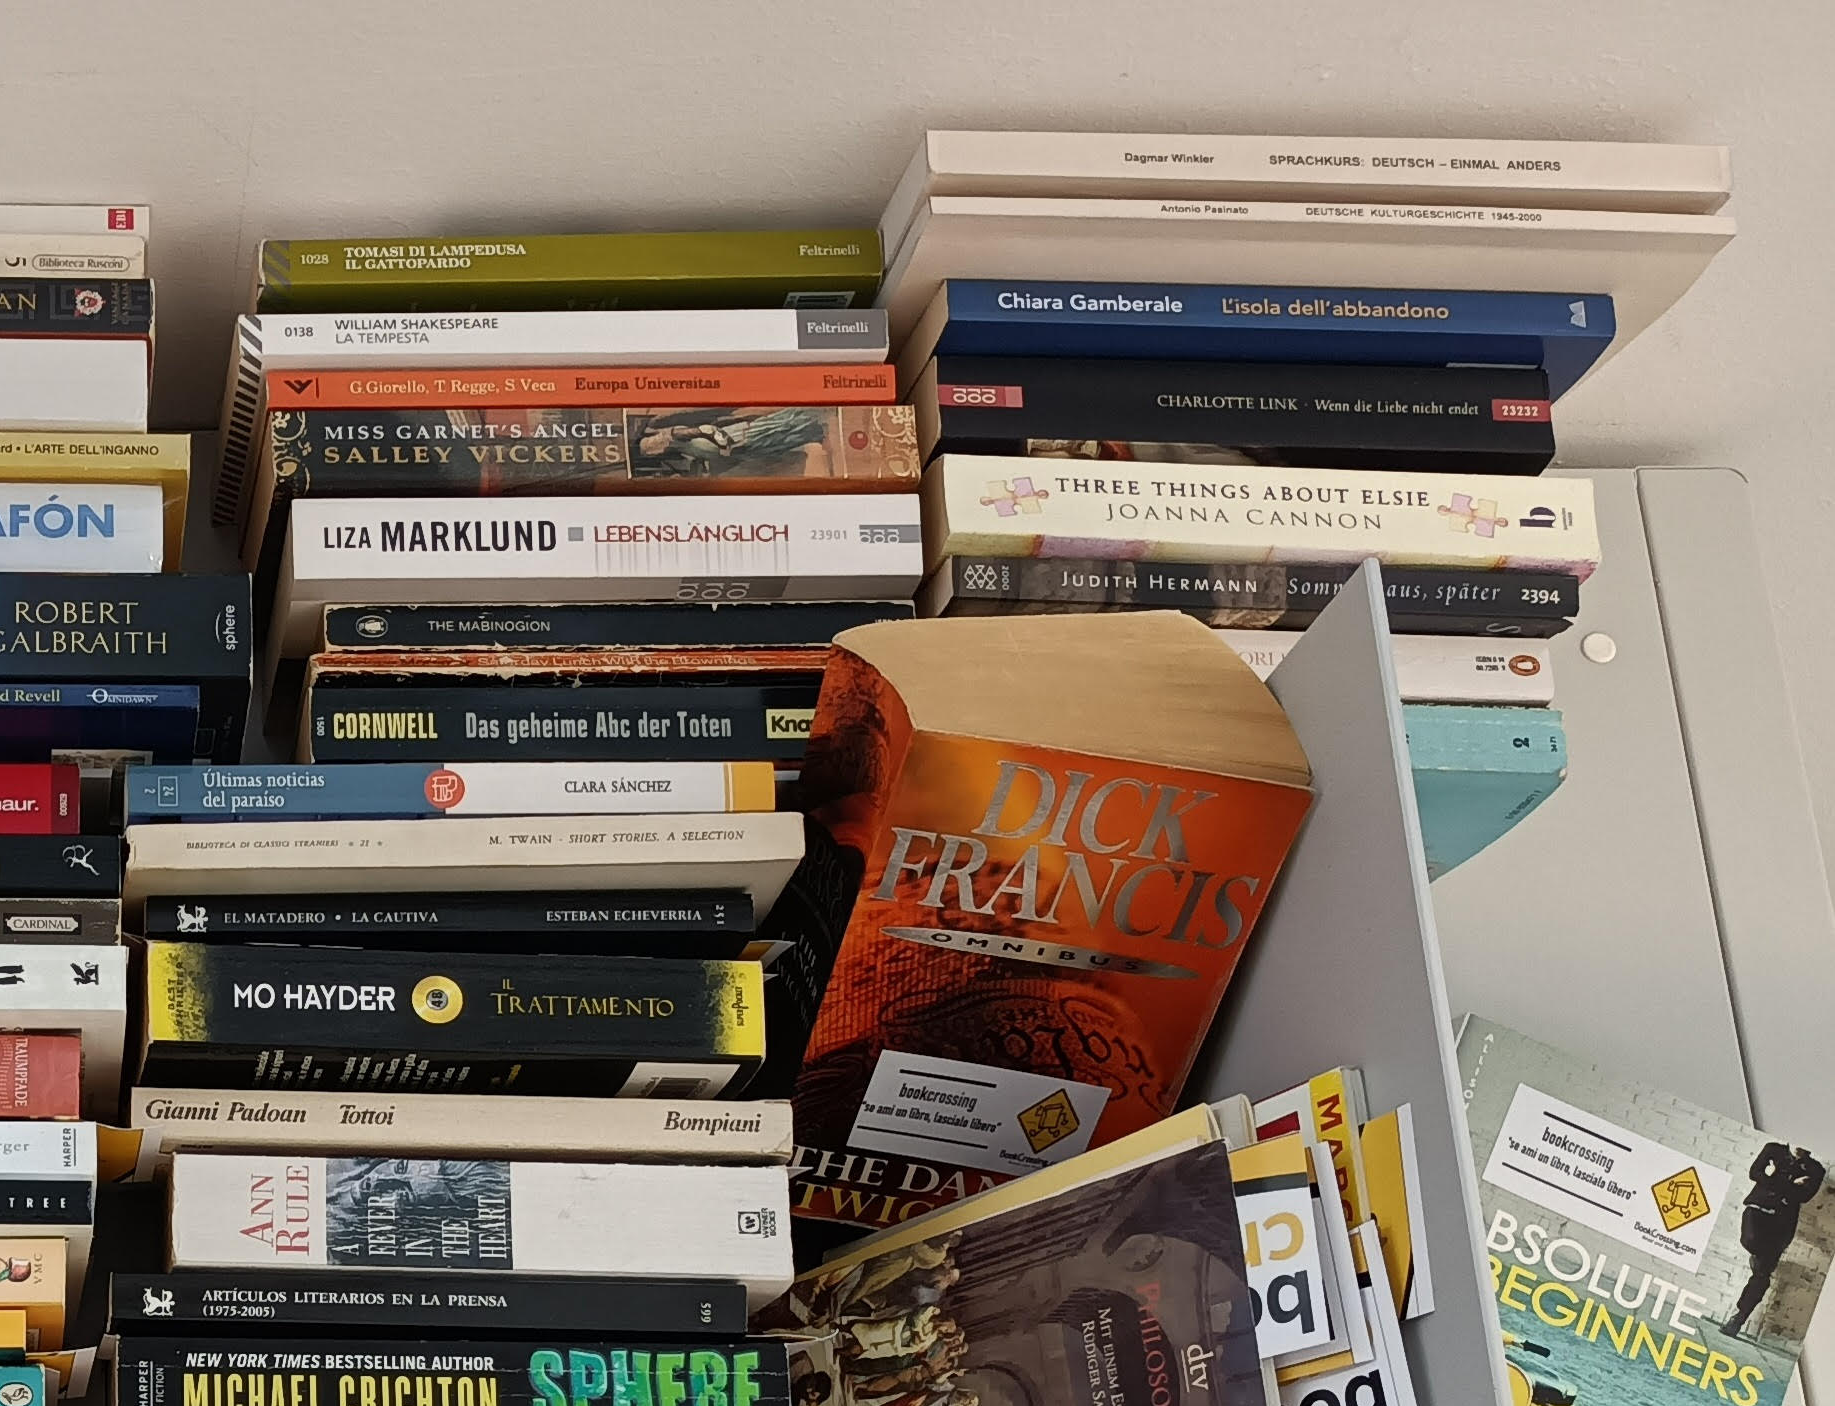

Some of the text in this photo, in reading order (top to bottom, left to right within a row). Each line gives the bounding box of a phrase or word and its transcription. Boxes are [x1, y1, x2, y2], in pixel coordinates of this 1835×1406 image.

[1123, 151, 1215, 165] Dagmar Winkler
[1160, 204, 1250, 215] Antonio Pasinato
[300, 243, 860, 265] 1028 TOMASI DI LAMPEDUSA Feltrinelli
[344, 257, 472, 271] IL GATTOPARDO
[997, 291, 1064, 311] Chiara
[1069, 293, 1184, 314] Gamberale
[283, 317, 869, 338] 0138 WILLIAM SHAKESPEARE Feltrinelli
[1501, 404, 1539, 417] 23232
[1054, 476, 1431, 508] THREE THINGS ABOUT ELSIE
[1106, 502, 1382, 530] JOANNA CANNON
[323, 520, 848, 553] LIZA MARKLUND LEBENSLÄNGLICH 23901
[14, 600, 139, 625] ROBERT
[332, 710, 733, 745] CORNWELL Das geheime Abc der Toten
[563, 776, 673, 794] CLARA SÁNCHEZ
[971, 759, 1220, 863] DICK
[868, 826, 1261, 950] FRANCIS
[233, 982, 396, 1012] MO HAYDER
[897, 1082, 978, 1111] bookcrossing
[145, 1098, 762, 1137] Gianni Padoan Tottoi Bompiani
[1185, 1344, 1210, 1391] dtv
